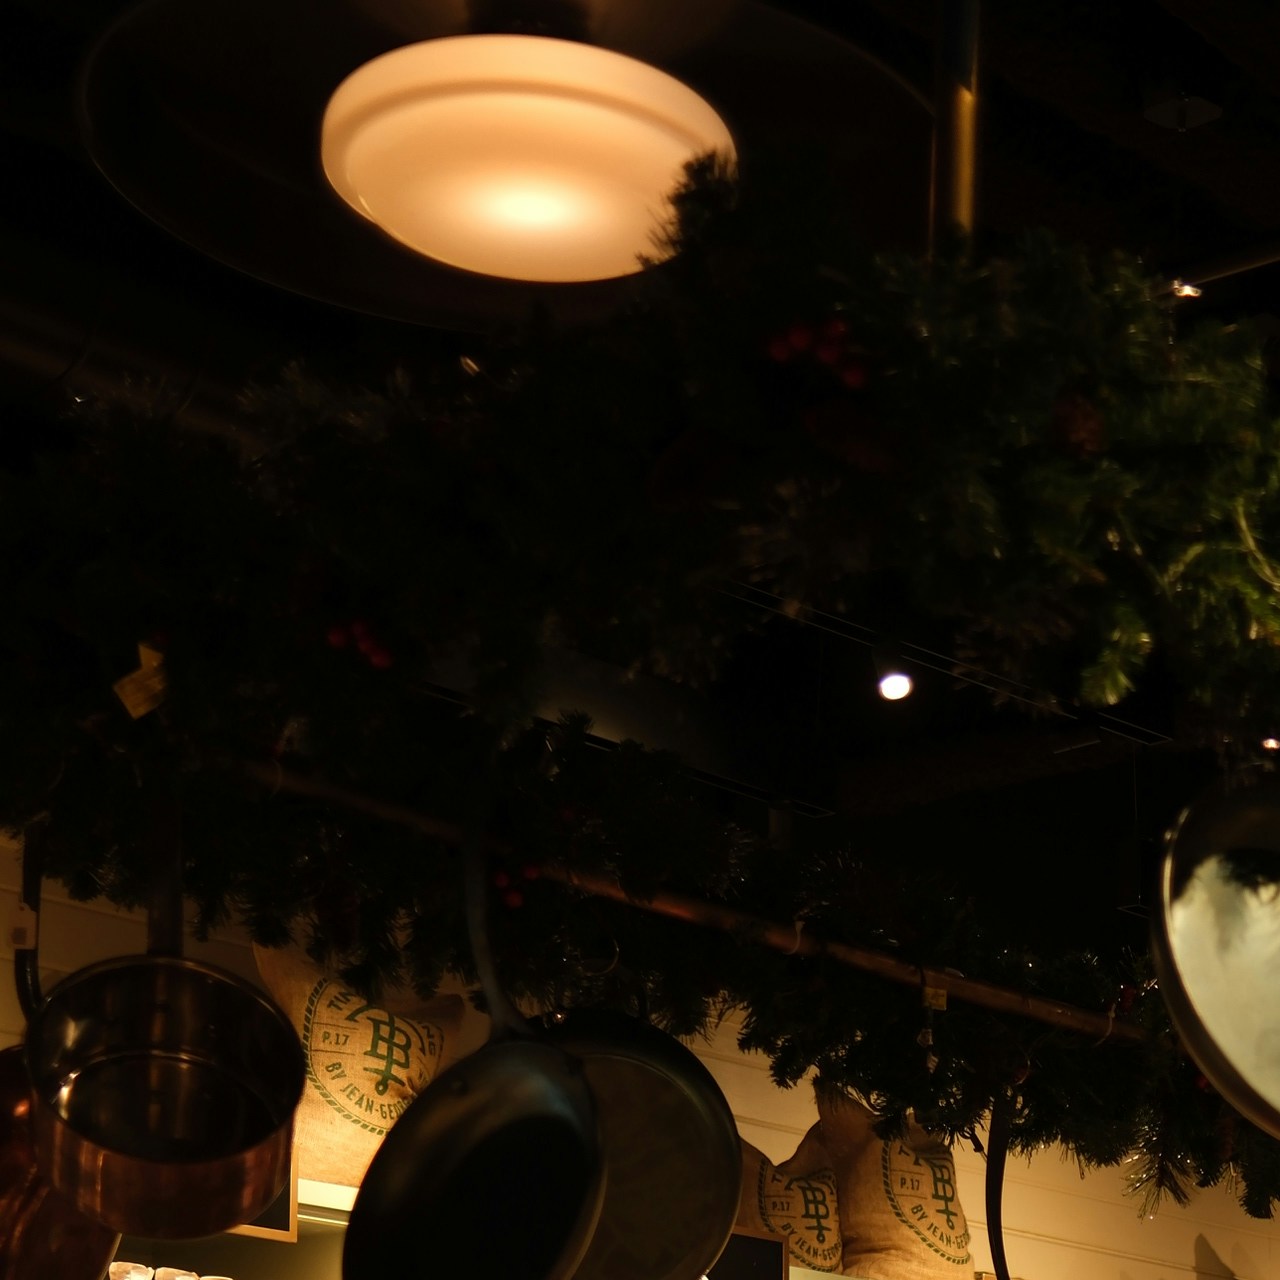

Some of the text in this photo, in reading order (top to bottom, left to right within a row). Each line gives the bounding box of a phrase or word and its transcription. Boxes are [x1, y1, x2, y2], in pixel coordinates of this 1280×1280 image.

[322, 1031, 350, 1046] P.17
[901, 1177, 920, 1191] P.17
[772, 1202, 790, 1212] P.17
[910, 1204, 928, 1222] BY
